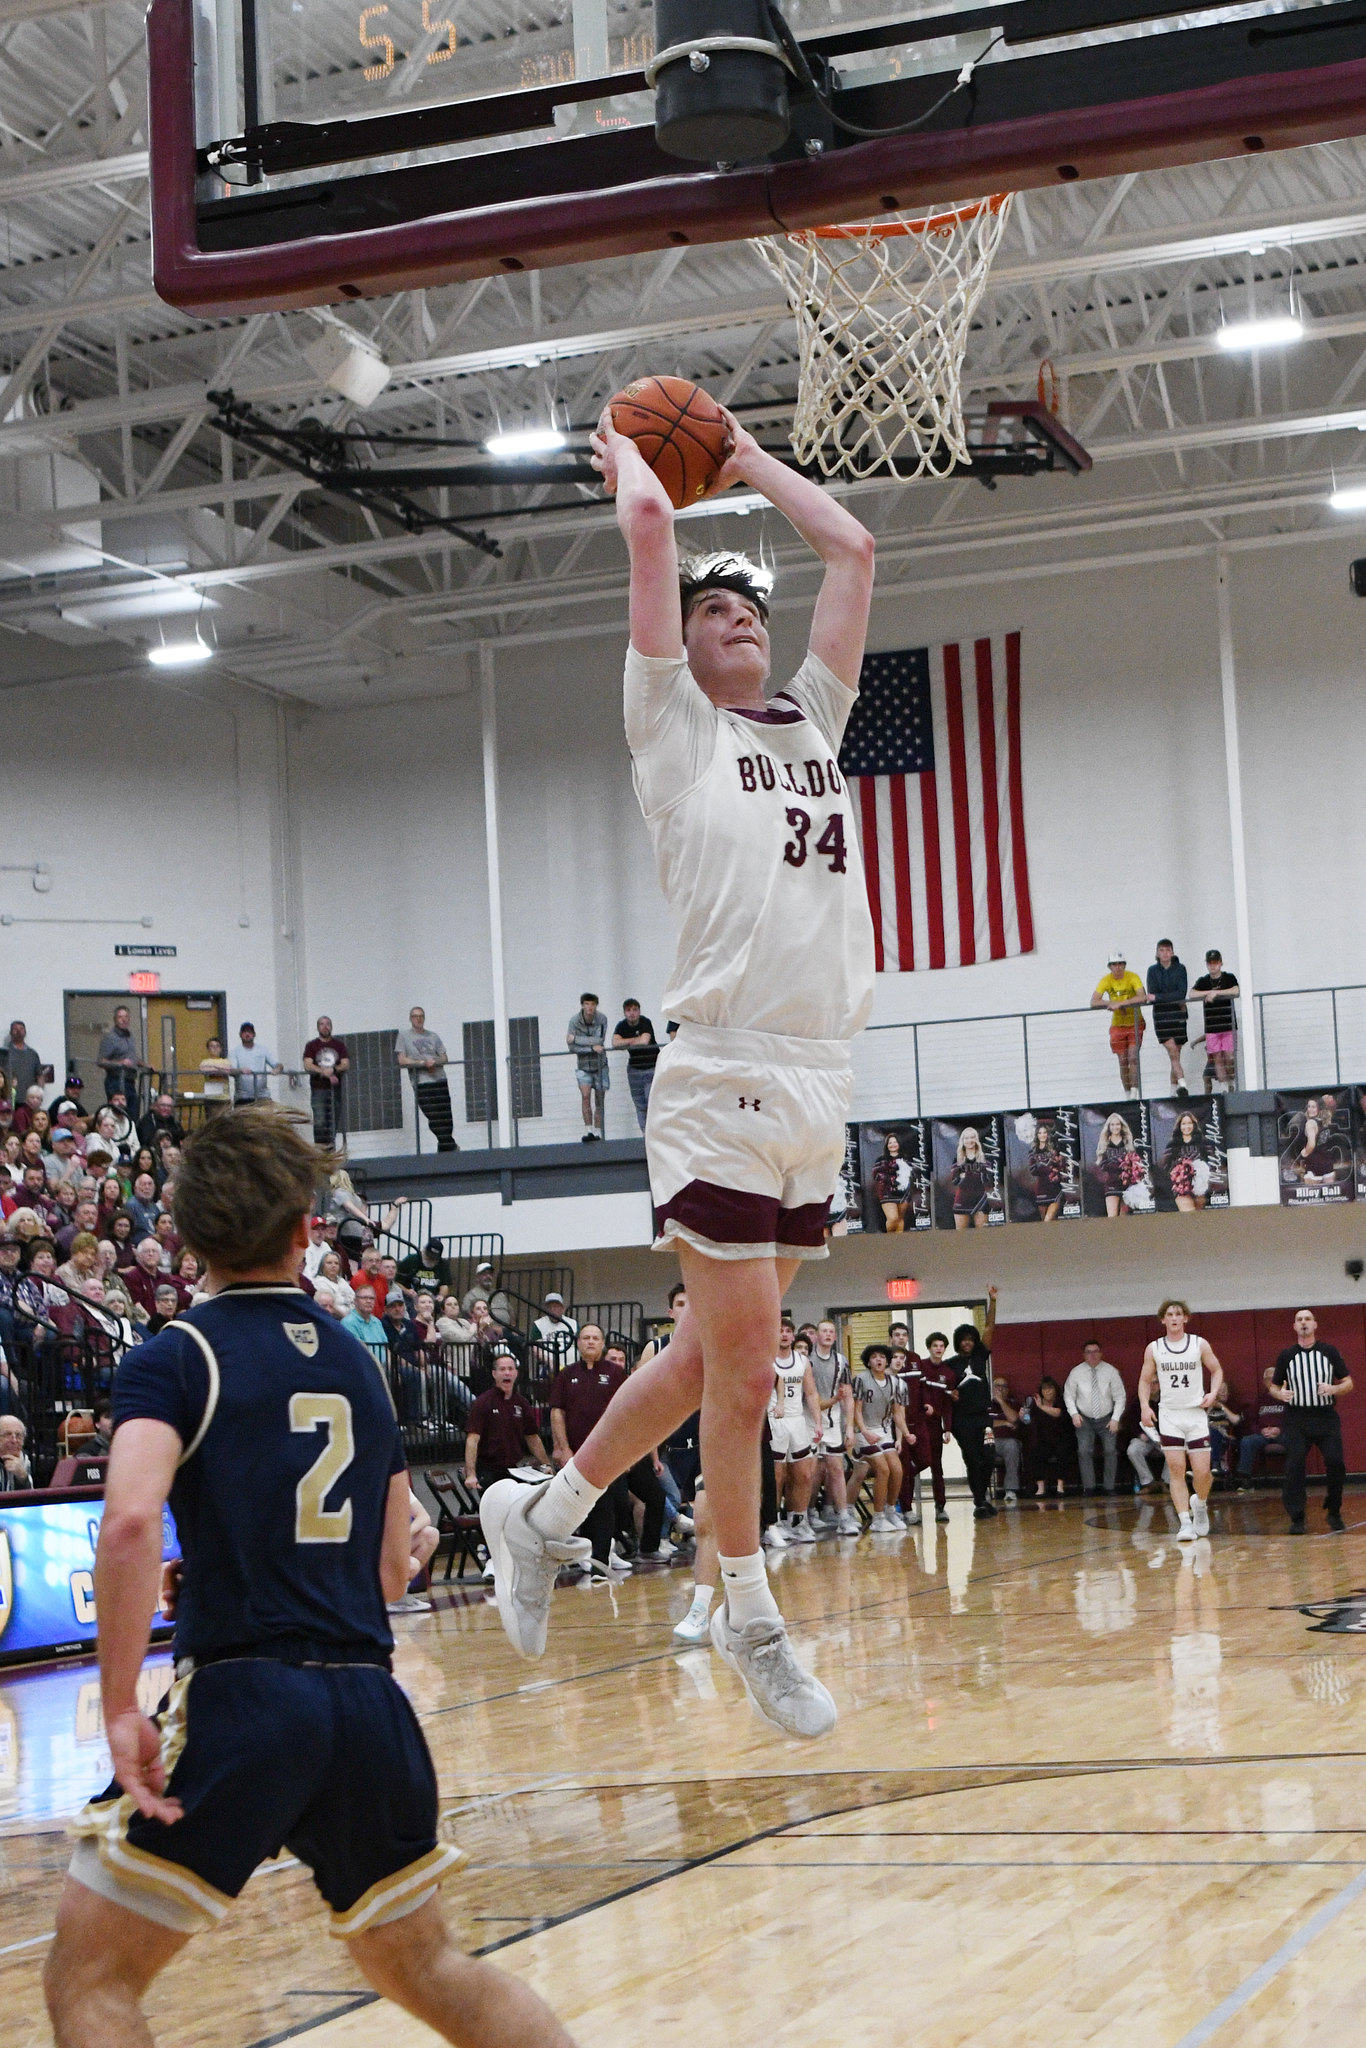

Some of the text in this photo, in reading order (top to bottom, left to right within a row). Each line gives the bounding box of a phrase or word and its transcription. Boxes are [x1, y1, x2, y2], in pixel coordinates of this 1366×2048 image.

[737, 754, 848, 797] BULLDO
[784, 806, 847, 874] 34
[982, 1115, 1001, 1157] Wilson
[1204, 1098, 1224, 1144] Allison
[985, 1159, 1002, 1200] Brooke
[1207, 1147, 1228, 1184] Molly
[1210, 1195, 1229, 1205] 2025
[1296, 1185, 1341, 1198] Riley Ball
[891, 1281, 911, 1298] EXIT
[1160, 1361, 1197, 1371] BULLDOGS
[1170, 1374, 1190, 1388] 24
[86, 1468, 100, 1480] POSS
[289, 1392, 355, 1544] 2
